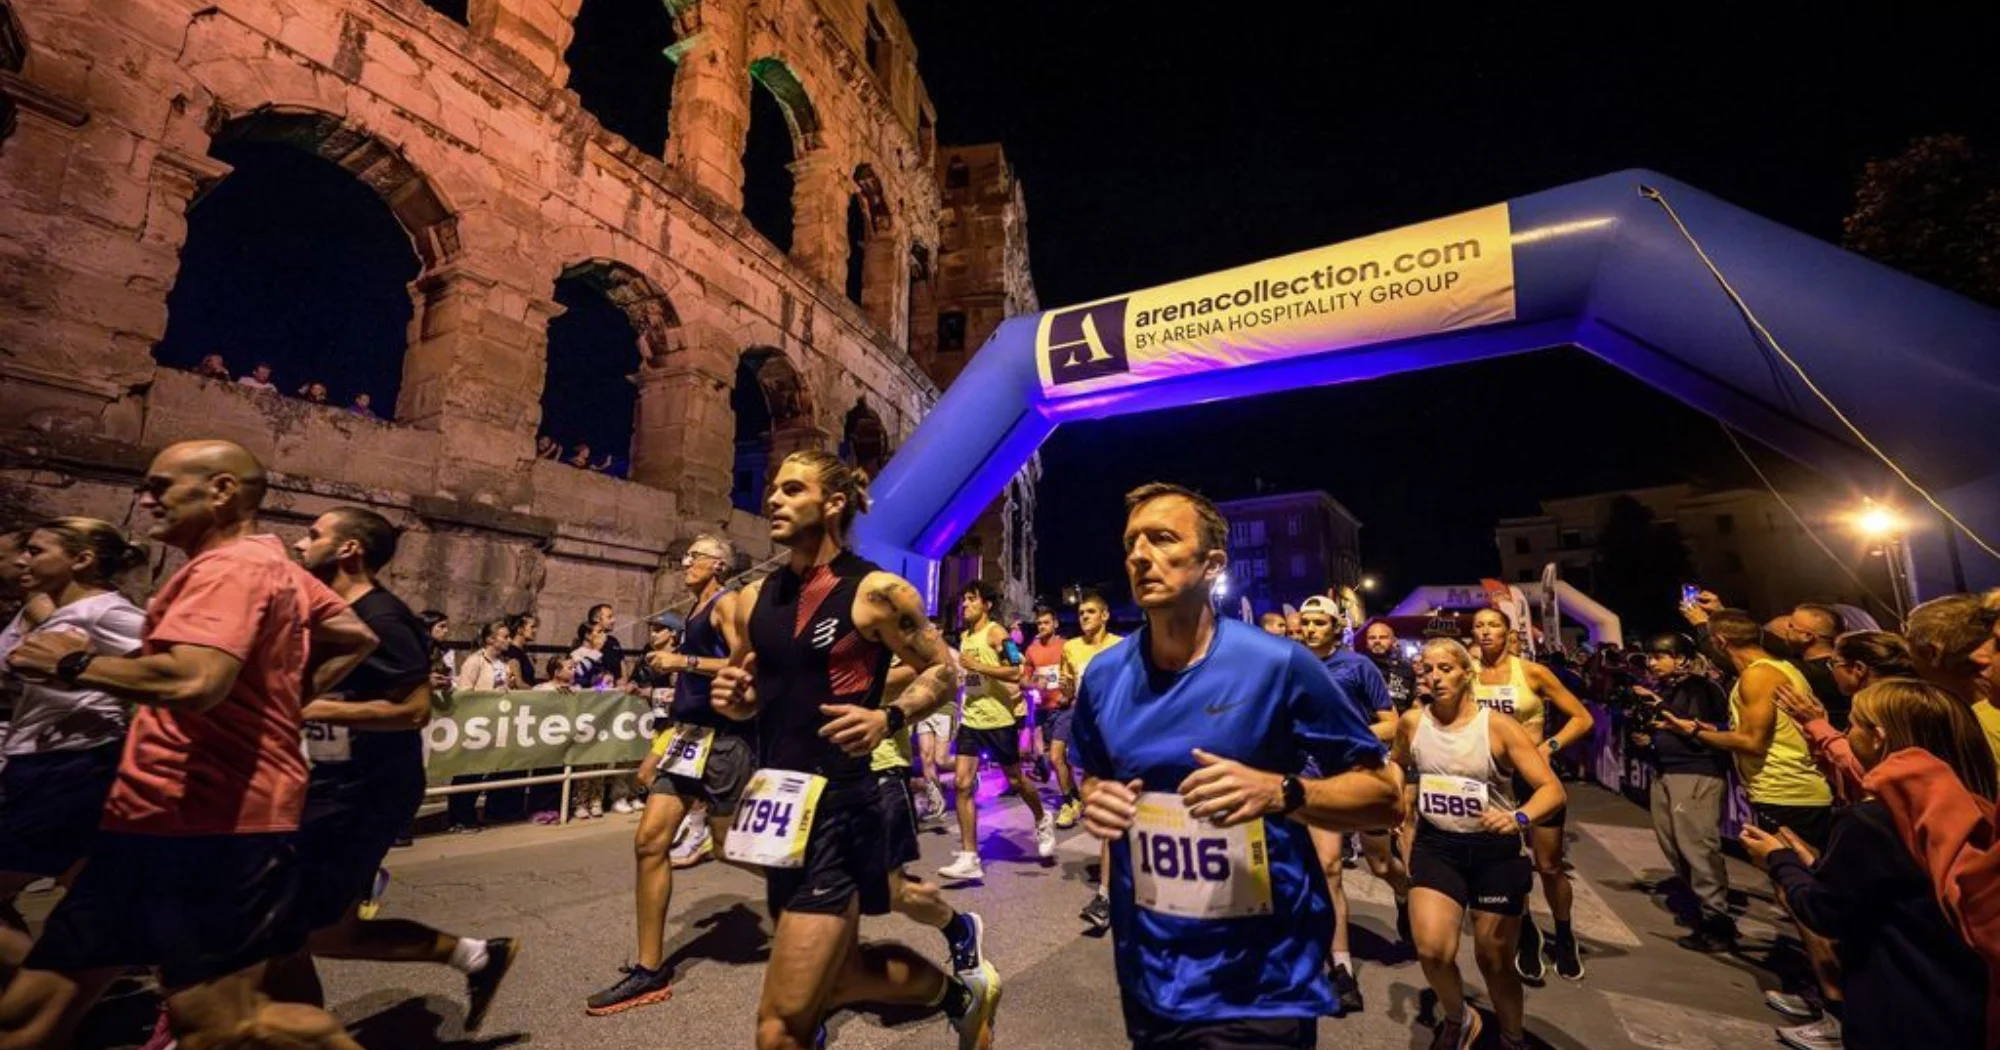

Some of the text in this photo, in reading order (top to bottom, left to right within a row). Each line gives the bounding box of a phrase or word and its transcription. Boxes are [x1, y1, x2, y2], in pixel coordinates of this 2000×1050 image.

[1135, 238, 1481, 328] arenacollection.com
[1136, 271, 1459, 349] BY ARENA HOSPITALITY GROUP
[1423, 793, 1483, 818] 1589
[1138, 831, 1231, 882] 1816
